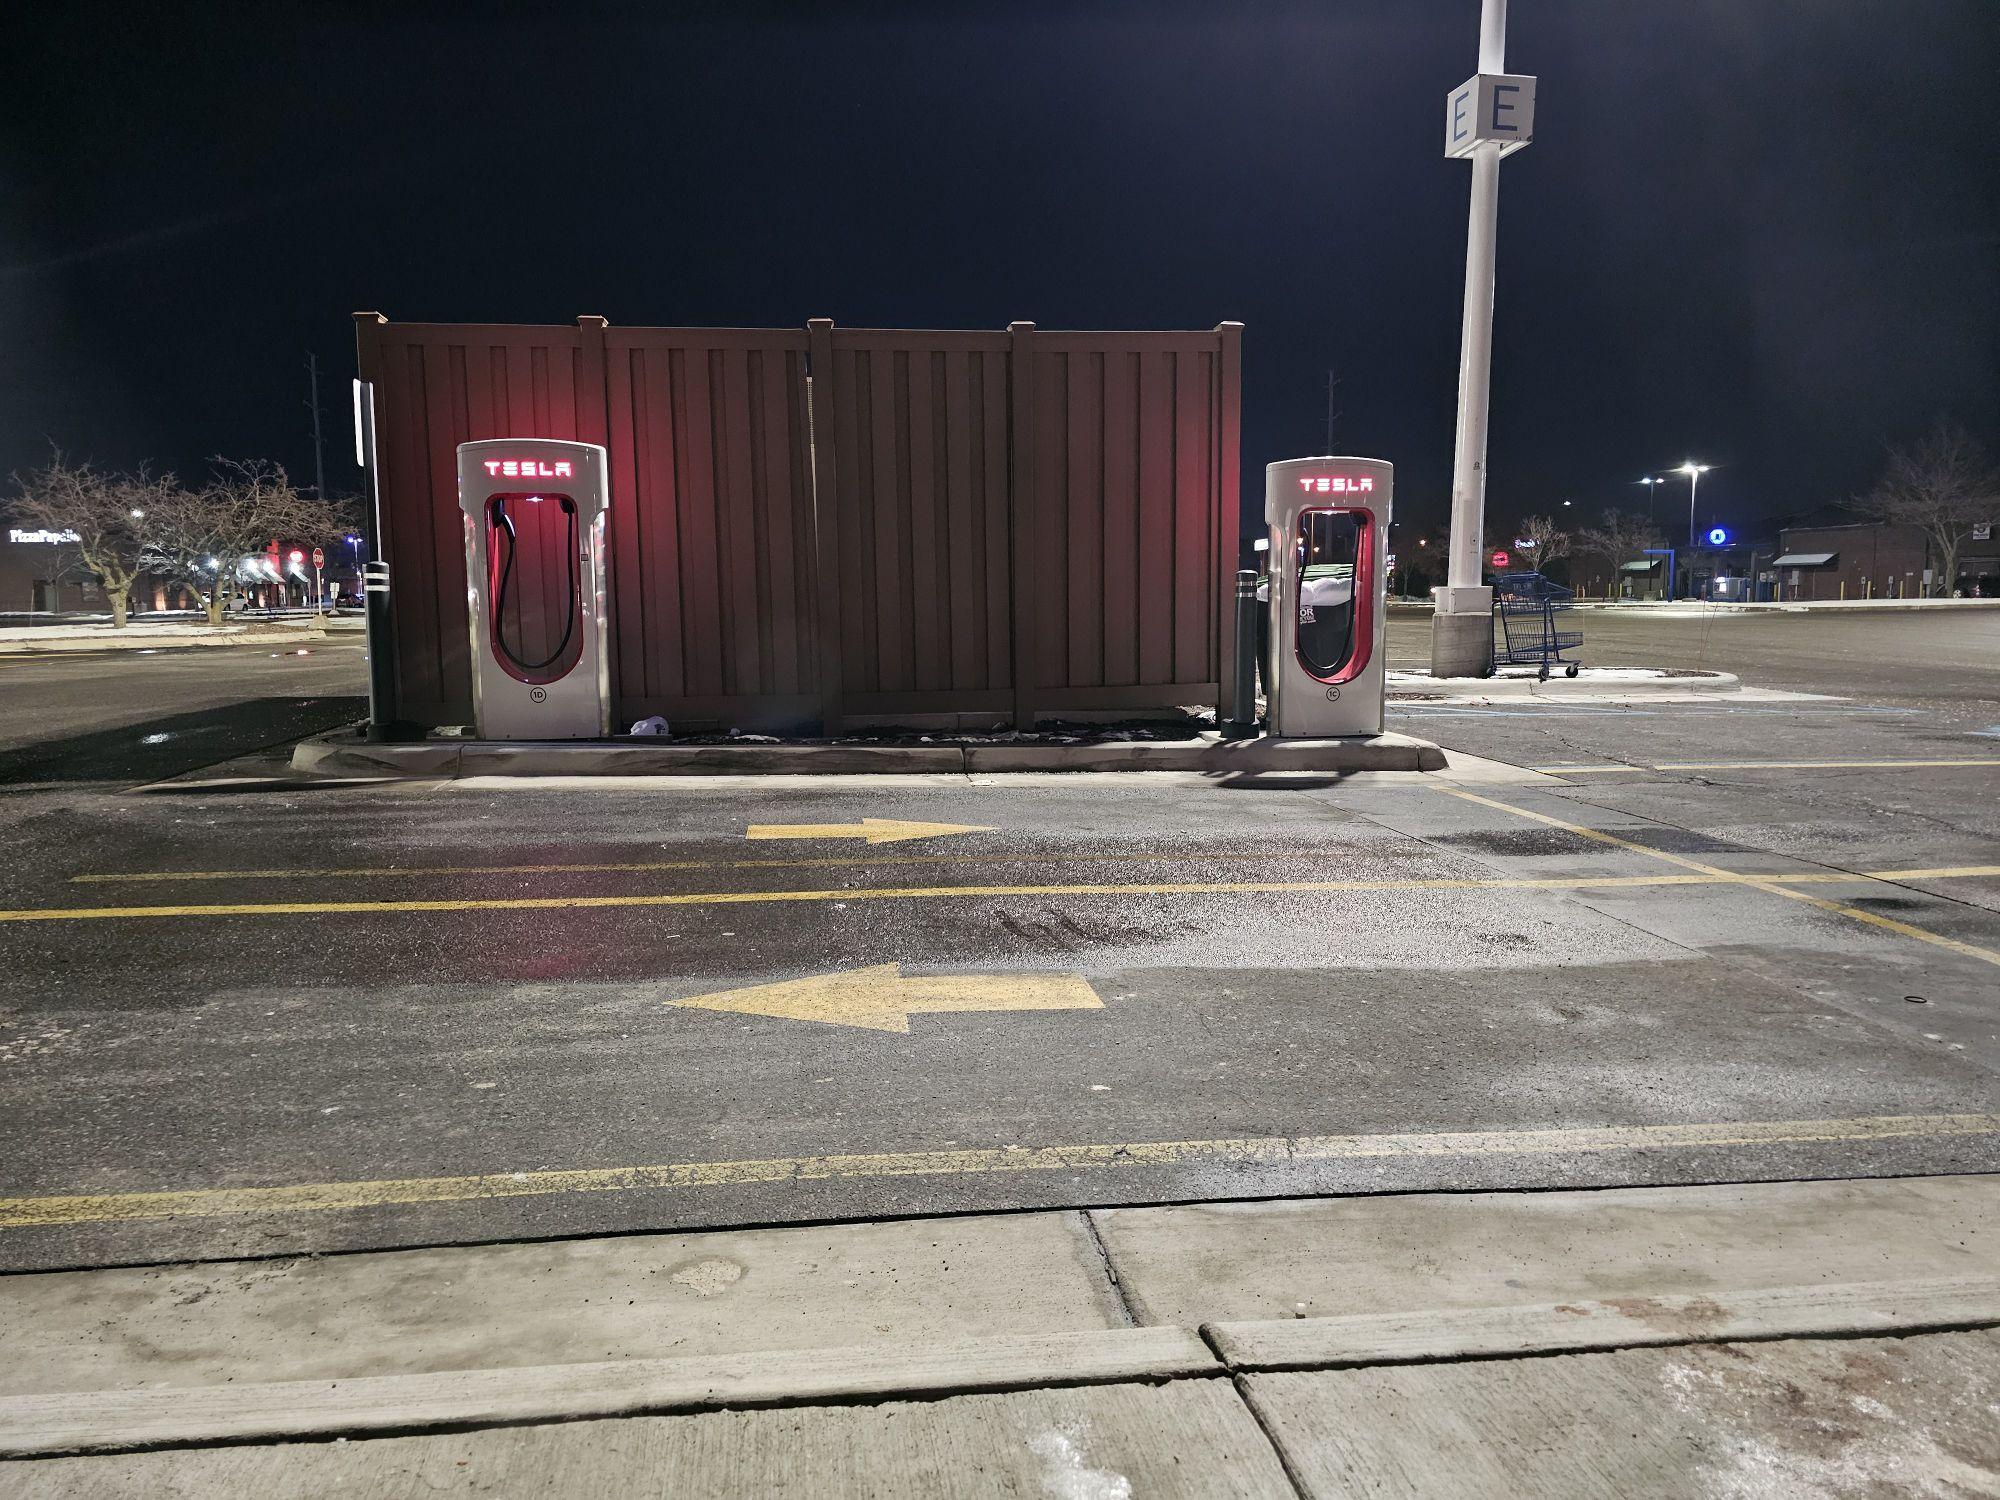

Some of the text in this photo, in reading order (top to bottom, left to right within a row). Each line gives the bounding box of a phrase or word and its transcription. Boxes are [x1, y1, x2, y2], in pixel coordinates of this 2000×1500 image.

[1492, 85, 1519, 131] E
[1453, 91, 1469, 142] E
[484, 461, 571, 476] TESLA
[1300, 478, 1372, 491] TESLA
[533, 691, 543, 699] 1D
